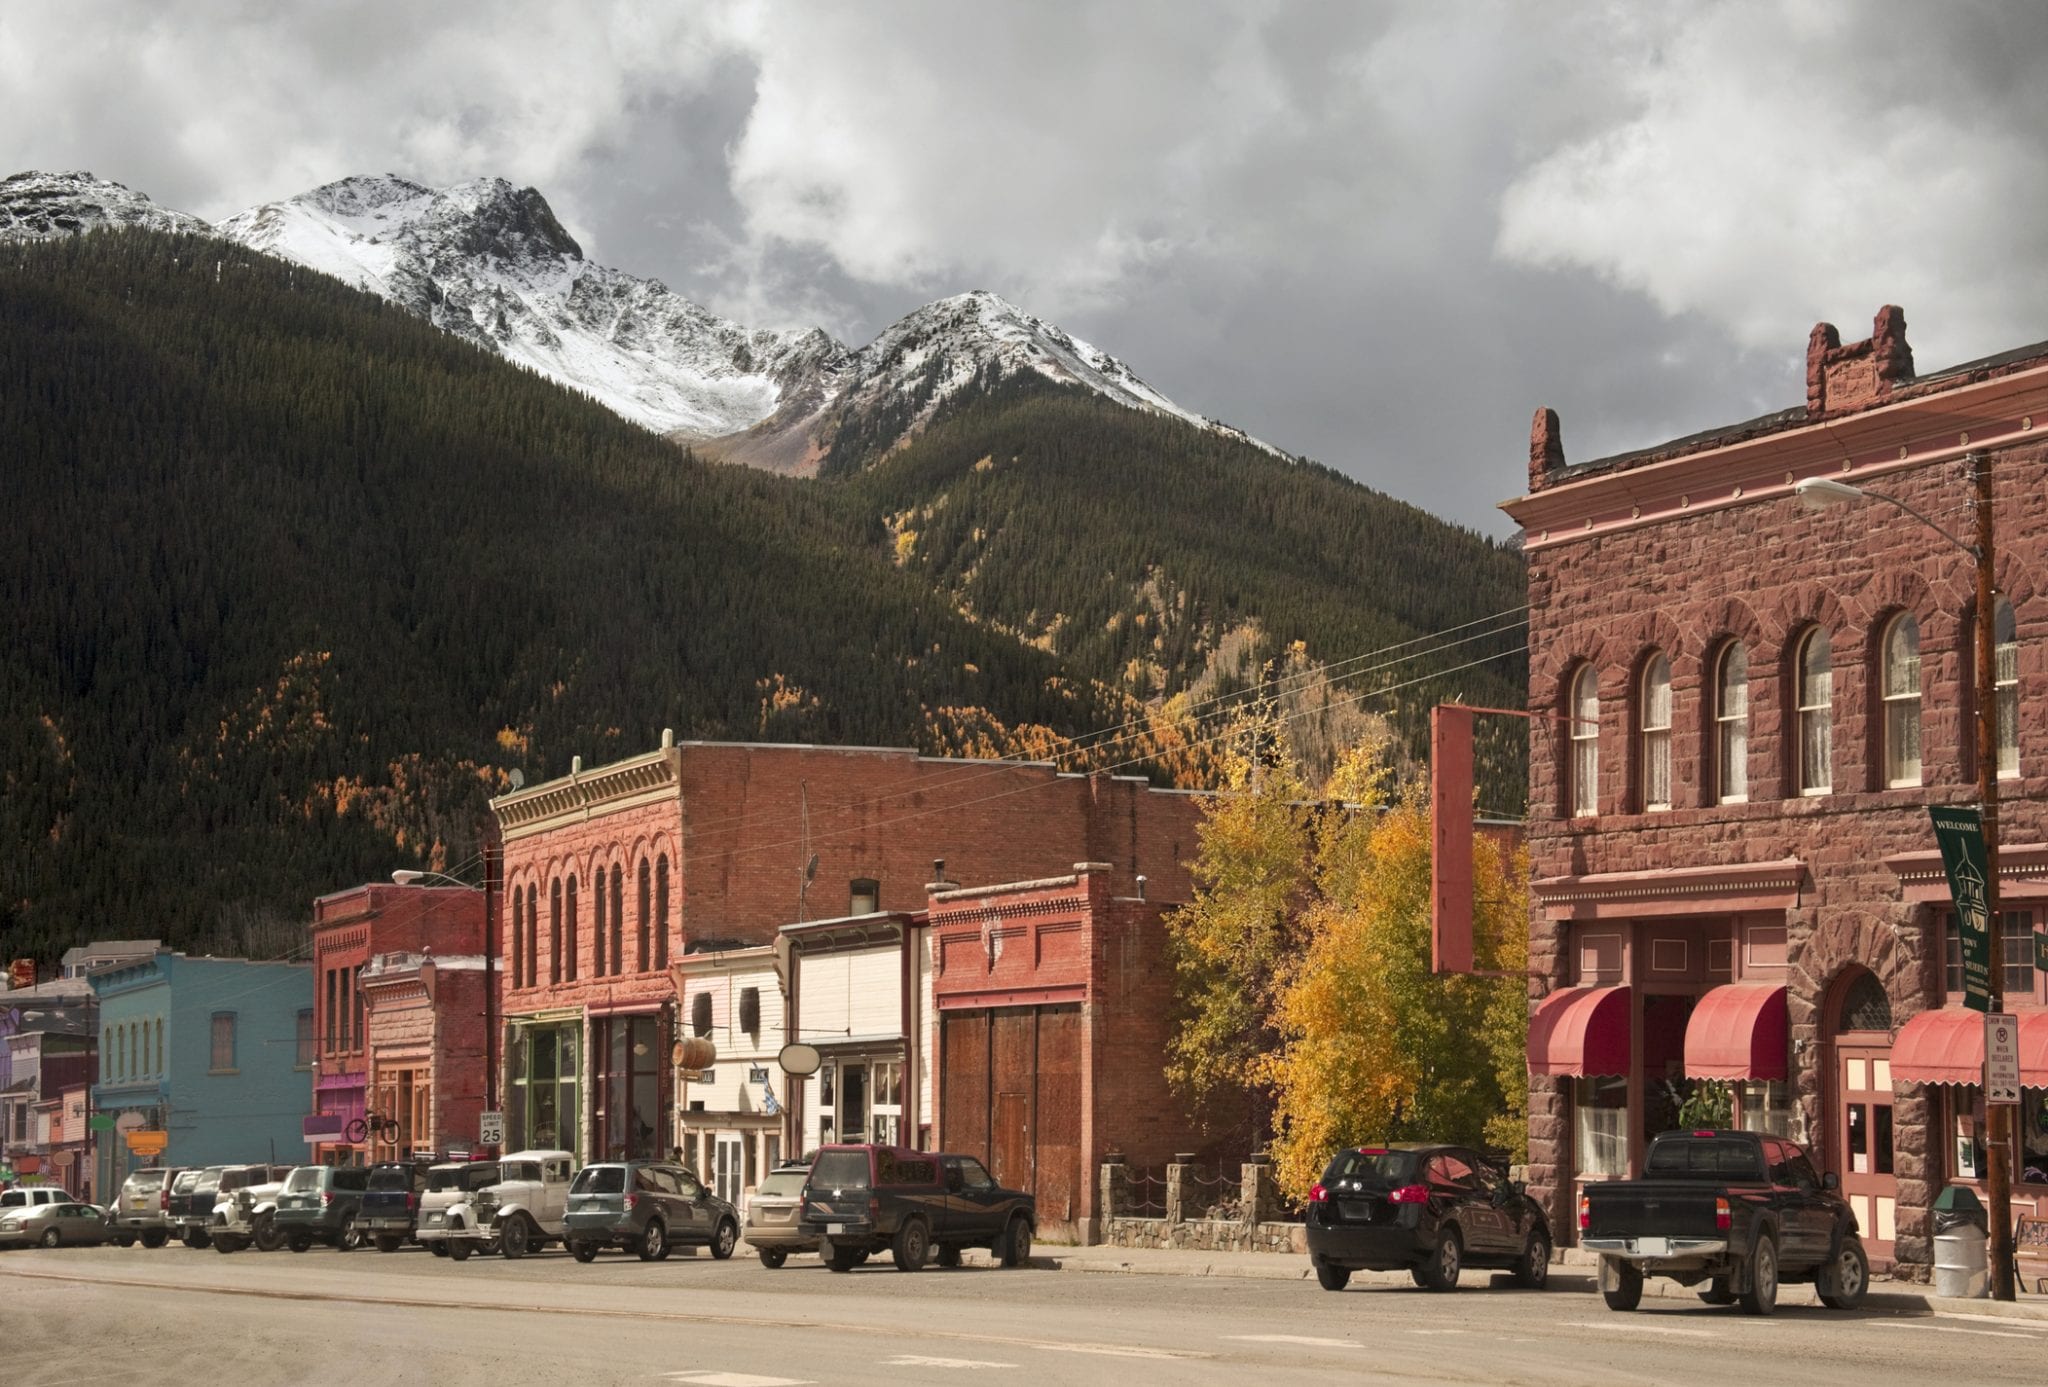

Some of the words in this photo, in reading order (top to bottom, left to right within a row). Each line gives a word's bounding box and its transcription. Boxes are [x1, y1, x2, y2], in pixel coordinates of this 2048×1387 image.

[1936, 820, 1979, 832] WELCOME
[1996, 1045, 2009, 1053] WHEN
[482, 1129, 501, 1143] 25
